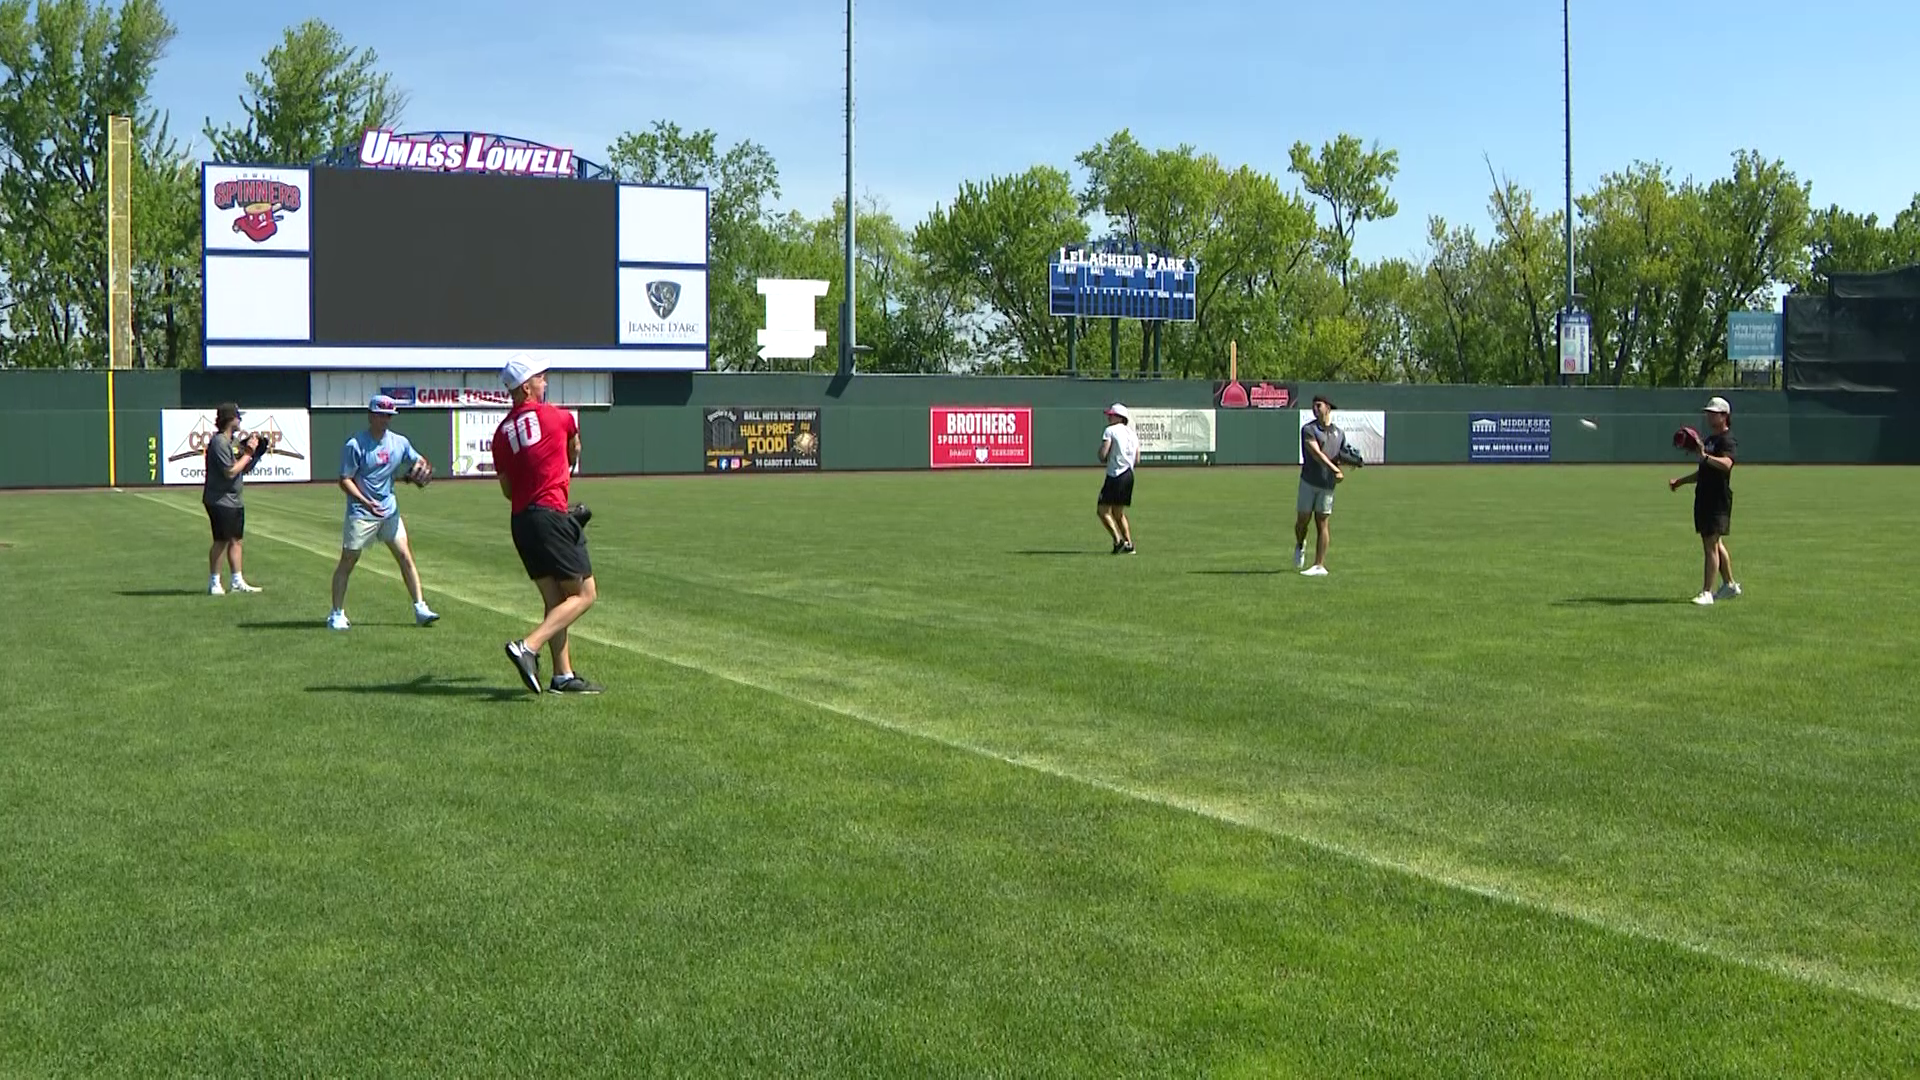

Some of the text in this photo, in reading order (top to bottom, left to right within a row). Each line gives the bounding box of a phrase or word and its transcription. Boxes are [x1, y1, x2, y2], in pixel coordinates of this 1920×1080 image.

[464, 133, 574, 176] LOWELL
[214, 180, 301, 212] SPINNERS
[1147, 253, 1186, 272] PARK
[1115, 269, 1135, 278] STRIKE
[1145, 271, 1157, 279] OUT
[417, 389, 459, 404] GAME
[743, 411, 761, 420] BALL
[762, 411, 778, 420] HITS
[947, 413, 1016, 434] BROTHERS
[1135, 423, 1159, 432] NICOSIA
[1500, 418, 1551, 427] MIDDLESEX
[502, 411, 542, 455] 10
[740, 425, 765, 437] HALF
[766, 423, 795, 436] PRICE
[1137, 432, 1172, 440] ASSOCIATES
[747, 436, 787, 454] FOOD!
[937, 435, 968, 444] SPORTS
[971, 435, 986, 444] BAR
[997, 435, 1023, 444] GRILLE
[794, 458, 818, 467] LOWELL
[275, 466, 294, 476] Inc.
